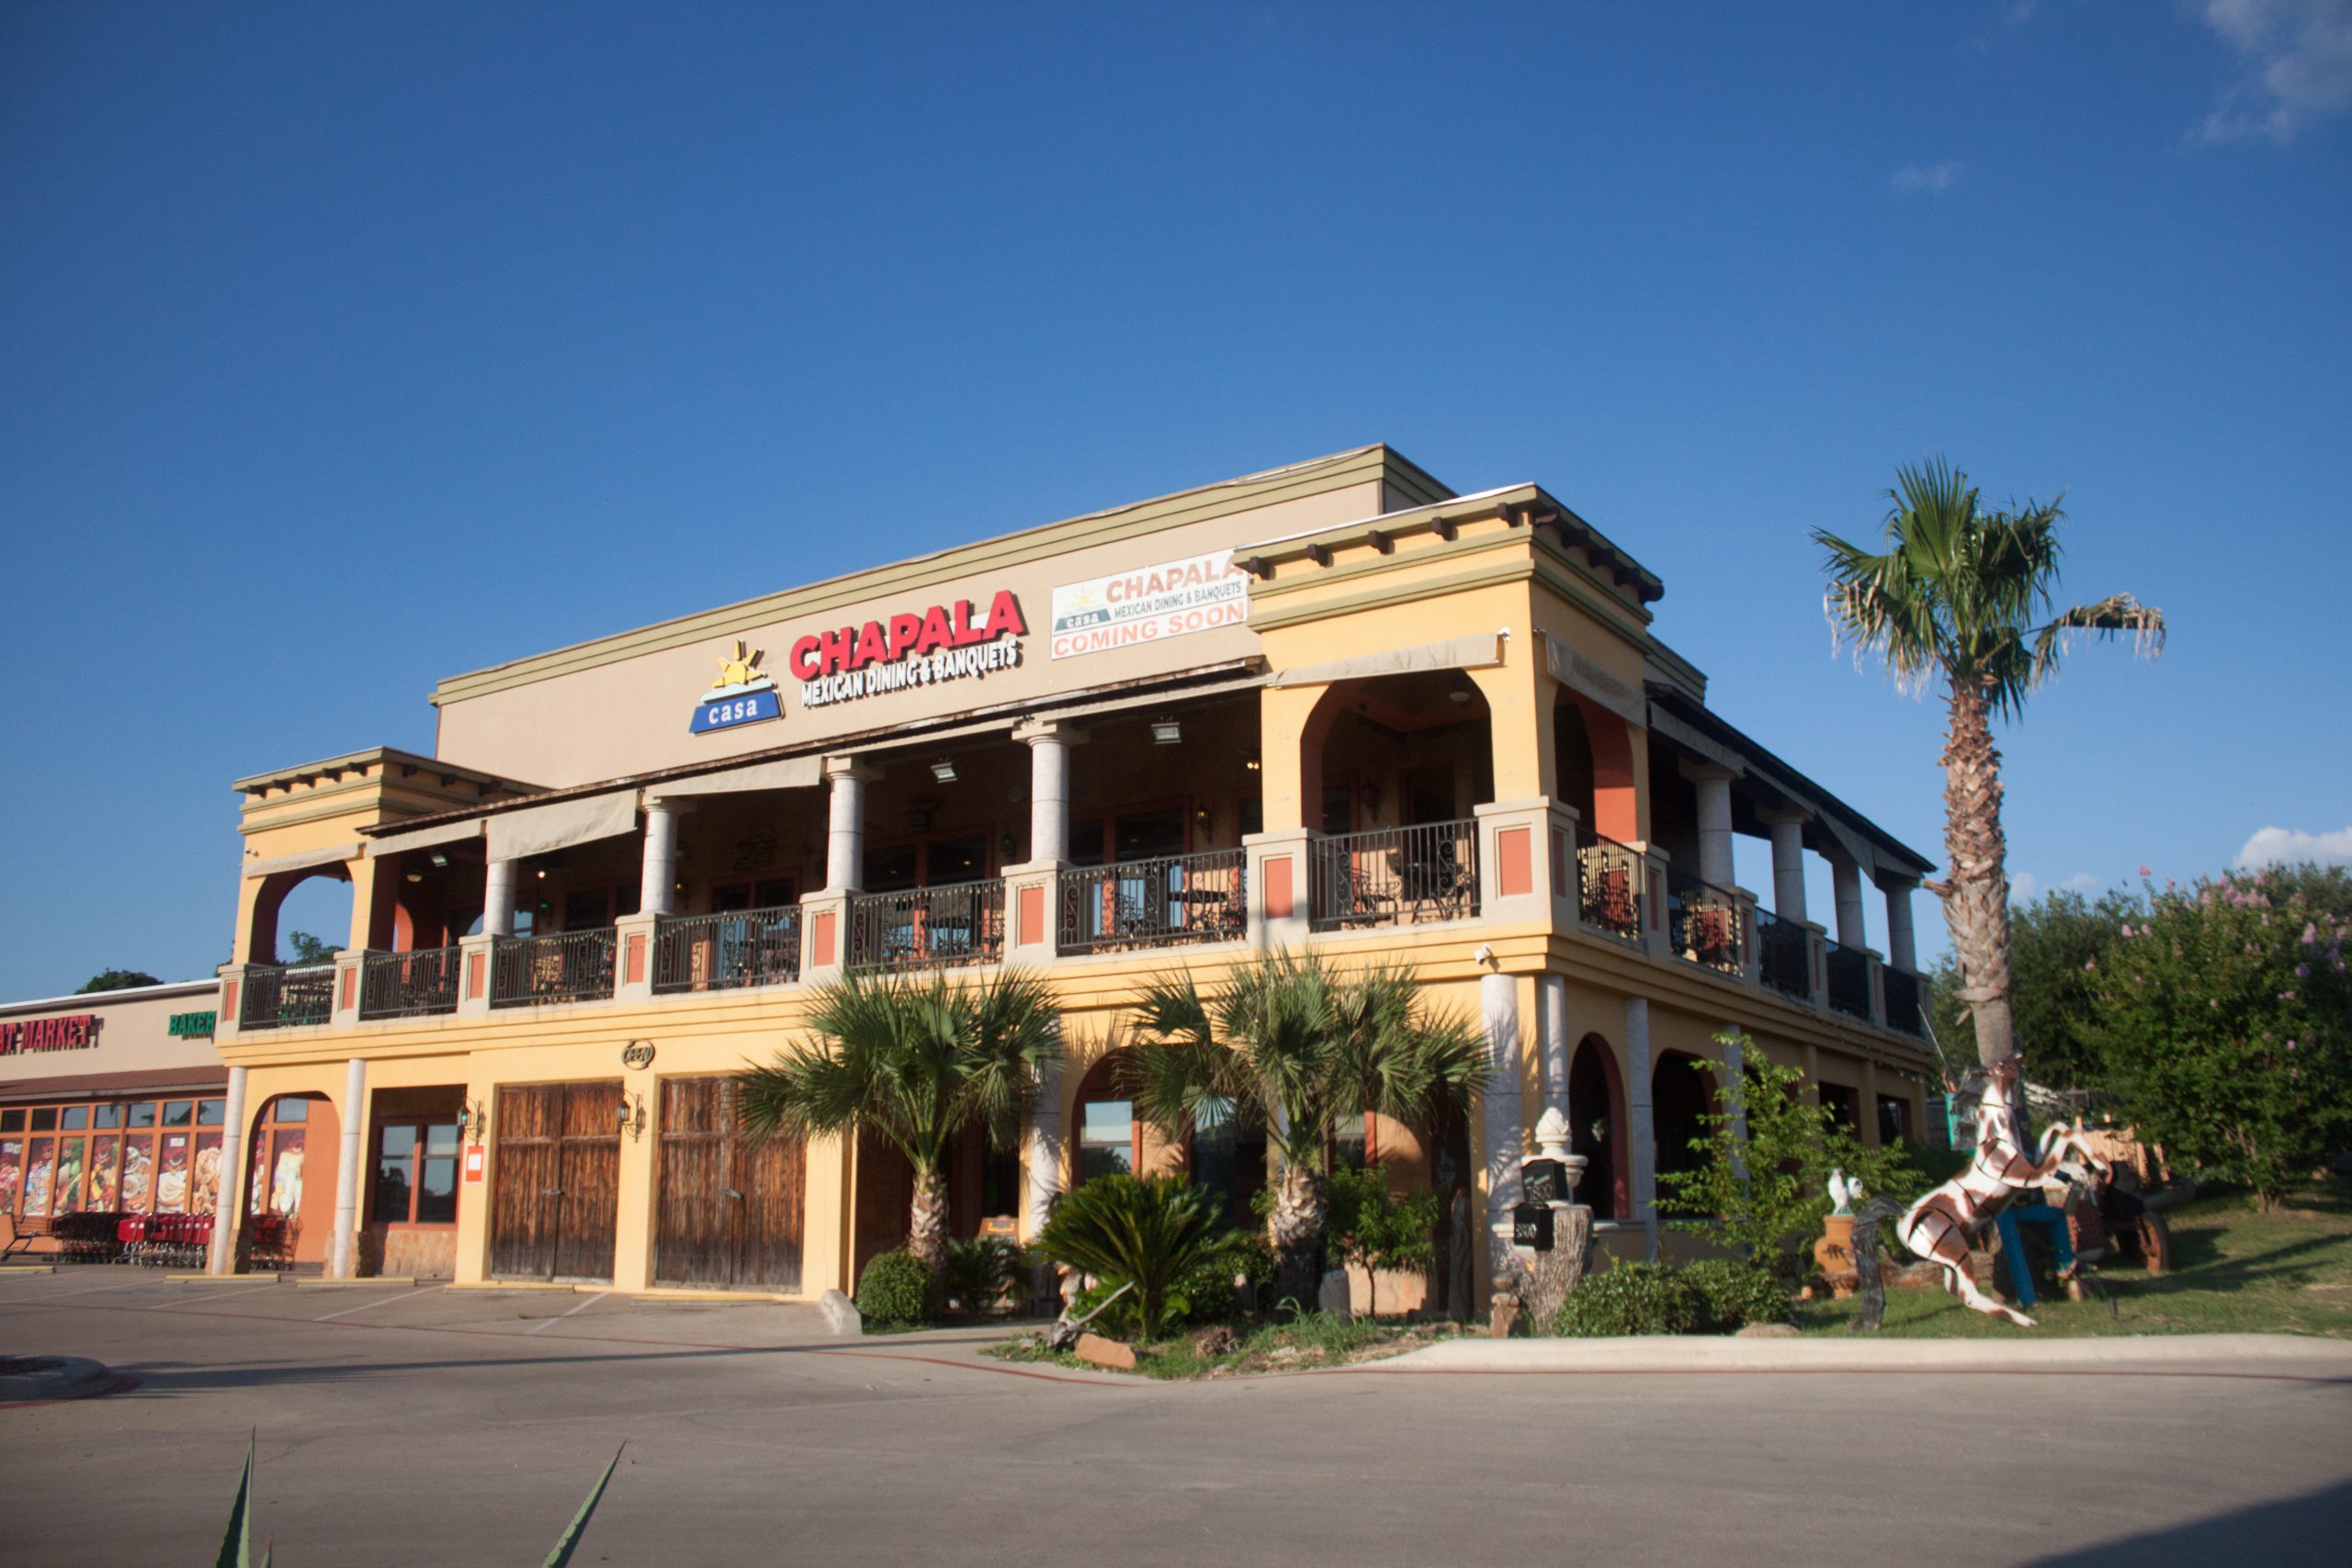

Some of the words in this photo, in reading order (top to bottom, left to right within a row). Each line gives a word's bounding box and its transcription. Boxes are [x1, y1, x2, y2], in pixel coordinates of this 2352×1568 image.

[1106, 555, 1243, 604] CHAPALA
[1114, 603, 1153, 619] MEXICAN
[1155, 595, 1183, 612] DINING
[1185, 592, 1193, 604] &
[1194, 581, 1241, 604] BANQUETS
[789, 590, 1024, 682] CHAPALA
[1054, 620, 1159, 657] COMING
[1168, 601, 1244, 635] SOON
[1066, 612, 1099, 628] casa
[800, 674, 865, 707] MEXICAN
[866, 657, 919, 694] DINING
[920, 659, 931, 682] &
[933, 638, 1018, 680] BANQUETS
[707, 698, 758, 725] casa
[20, 1014, 92, 1050] MARKET
[168, 1010, 217, 1036] BAKER
[622, 1045, 653, 1063] OPEN
